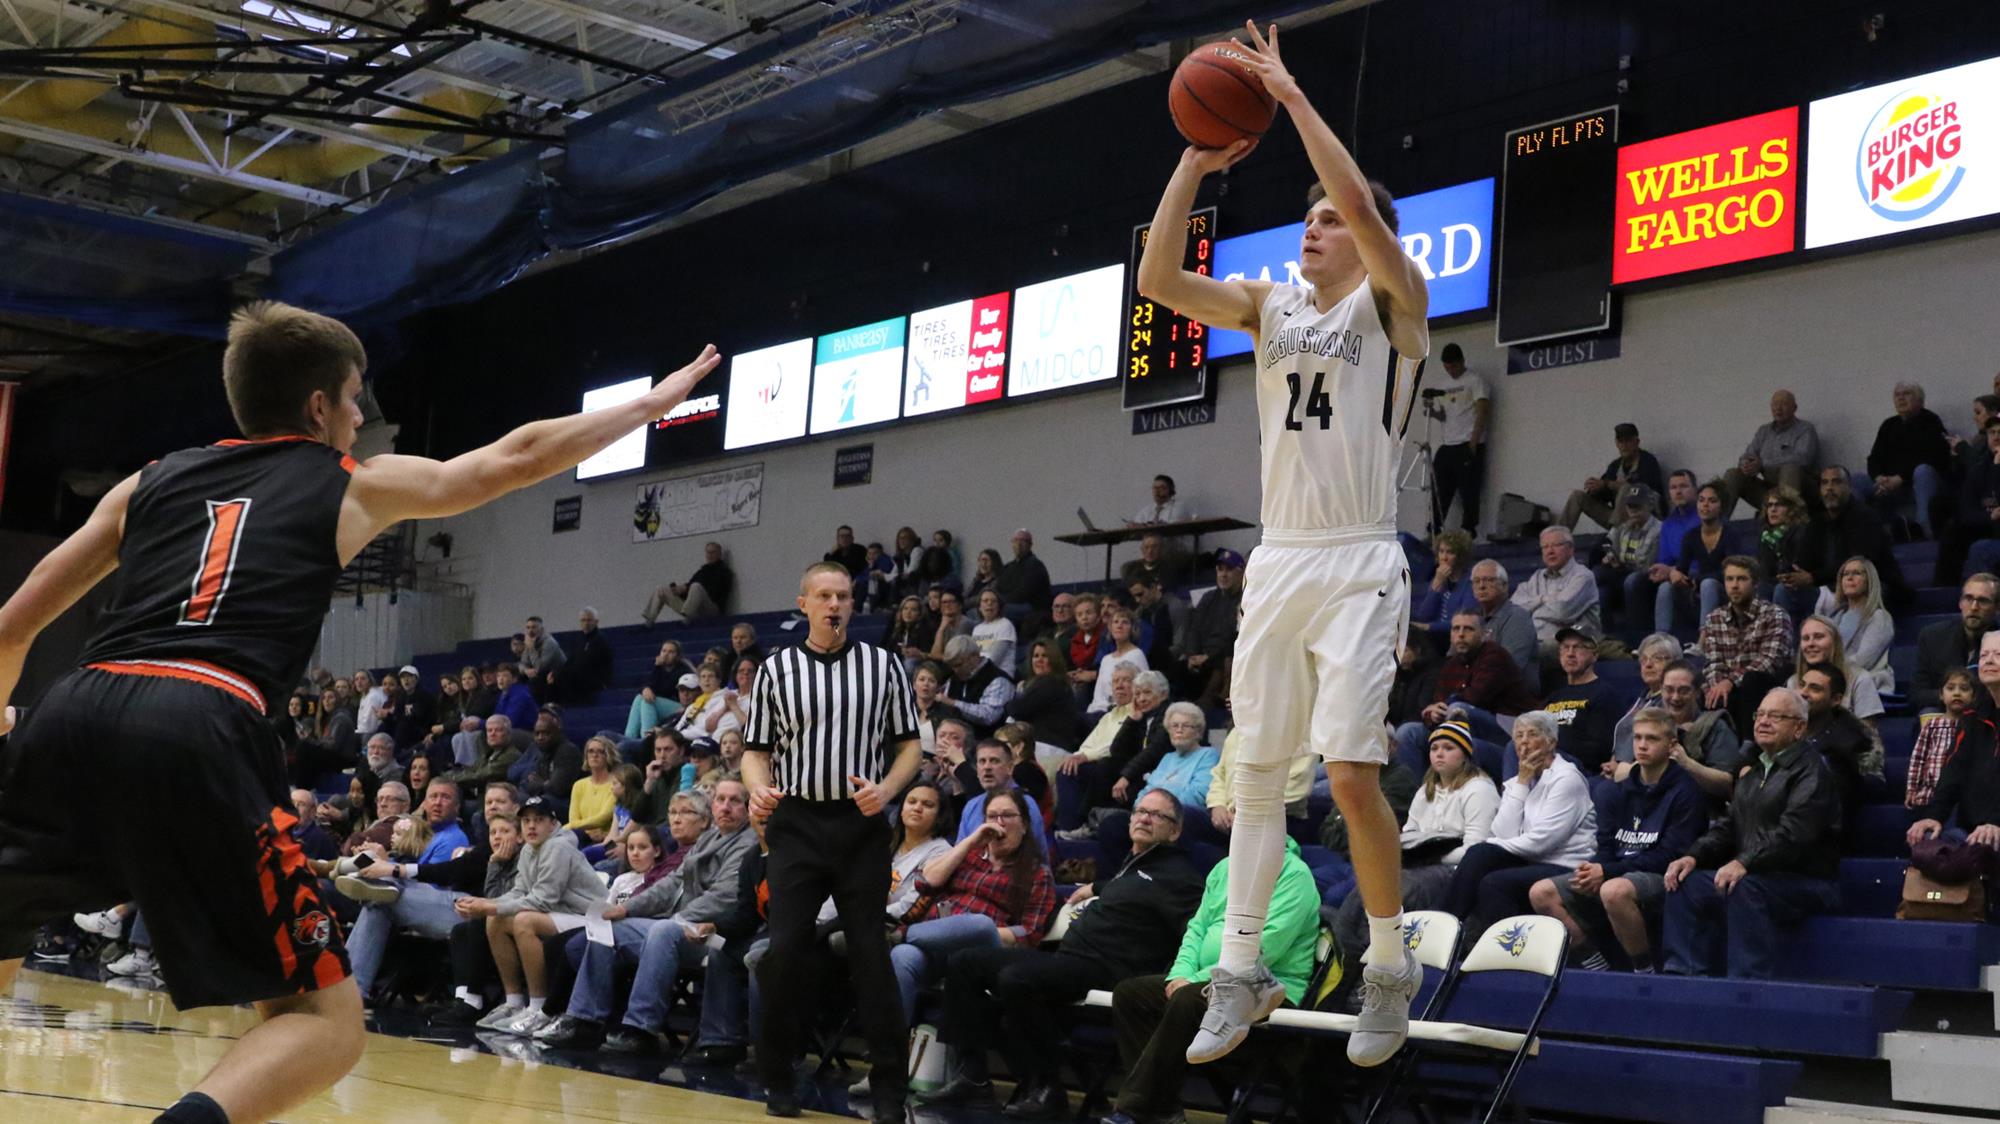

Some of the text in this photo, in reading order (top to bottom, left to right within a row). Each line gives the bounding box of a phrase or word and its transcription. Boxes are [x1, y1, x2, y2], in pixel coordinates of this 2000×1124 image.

[1516, 117, 1604, 156] PLY FL PTS
[1867, 101, 1957, 169] BURGER
[1626, 138, 1789, 206] WELLS
[1871, 124, 1961, 201] KING
[1626, 188, 1784, 254] FARGO
[914, 319, 946, 337] TIRES
[1133, 303, 1153, 326] 23
[924, 331, 955, 348] TIRES
[933, 344, 965, 360] TIRES
[1131, 330, 1151, 351] 24
[1187, 320, 1202, 339] 15
[1021, 344, 1103, 389] MIDCO
[1130, 355, 1149, 378] 35
[1192, 345, 1201, 367] 3
[1528, 339, 1598, 370] GUEST
[1140, 405, 1209, 431] VIKINGS
[1285, 372, 1333, 431] 24
[177, 498, 252, 626] 1
